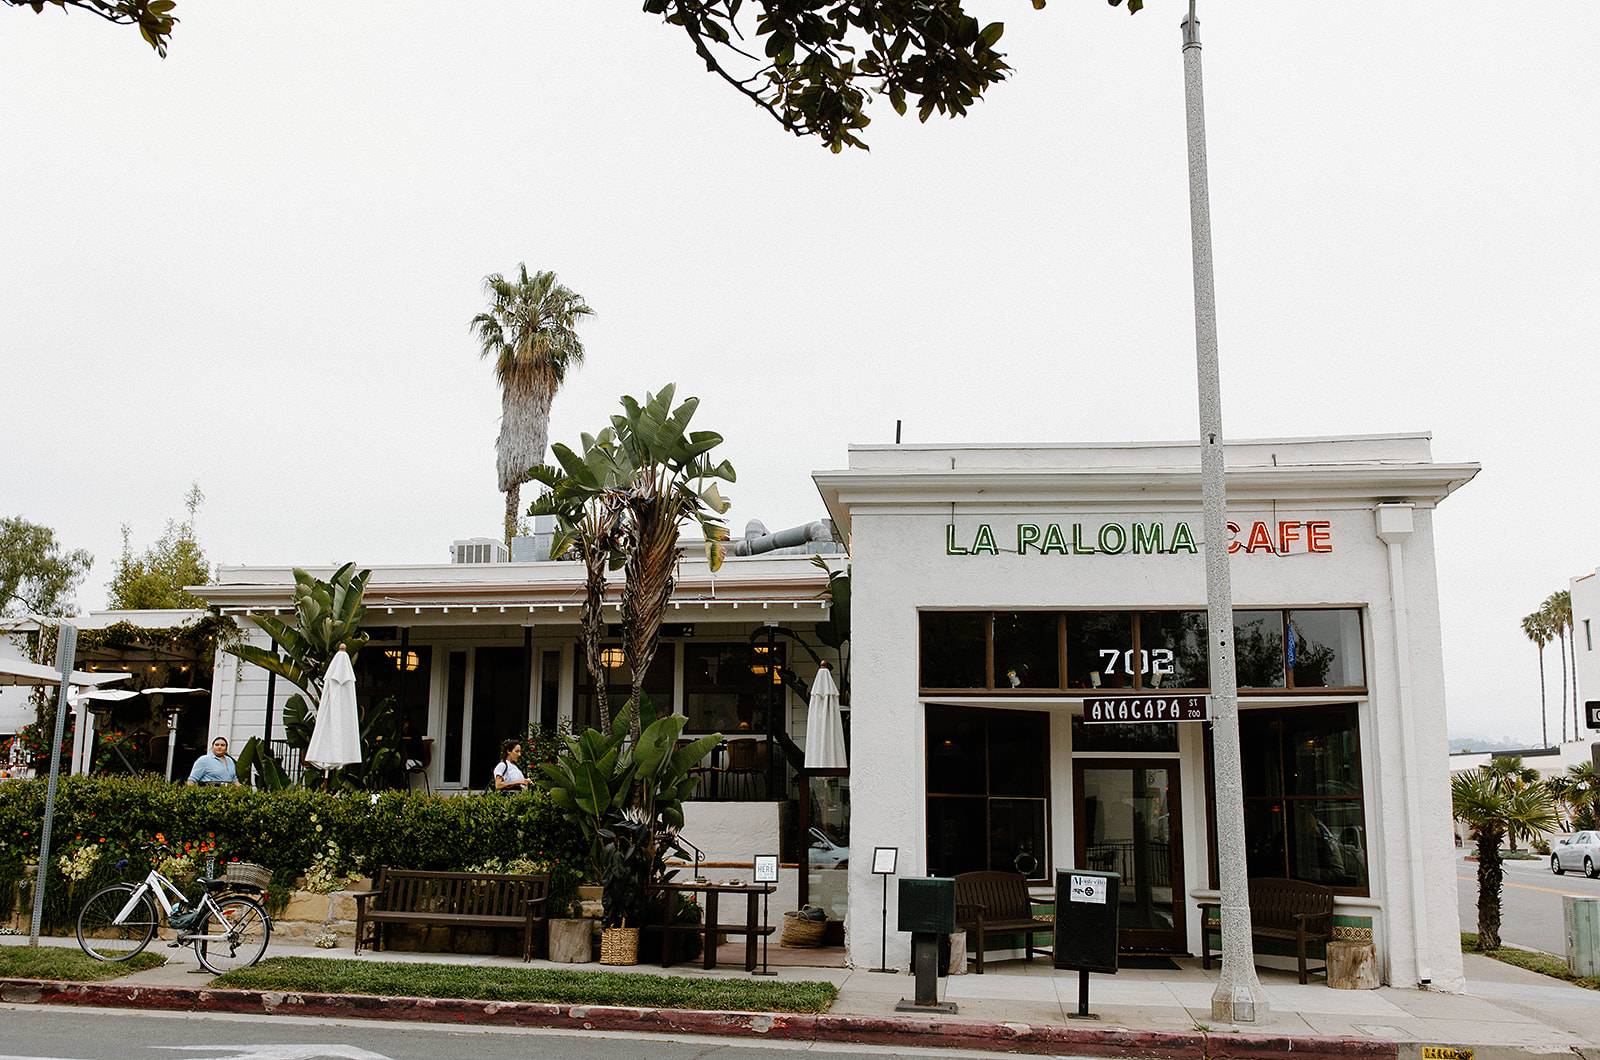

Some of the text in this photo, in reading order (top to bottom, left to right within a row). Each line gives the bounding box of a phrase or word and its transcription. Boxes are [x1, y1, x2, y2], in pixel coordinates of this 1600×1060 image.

[946, 523, 999, 556] LA
[1017, 522, 1198, 556] PALOMA
[1099, 648, 1174, 675] 702
[1091, 699, 1198, 720] ANACAPA ST
[1188, 709, 1201, 718] 700
